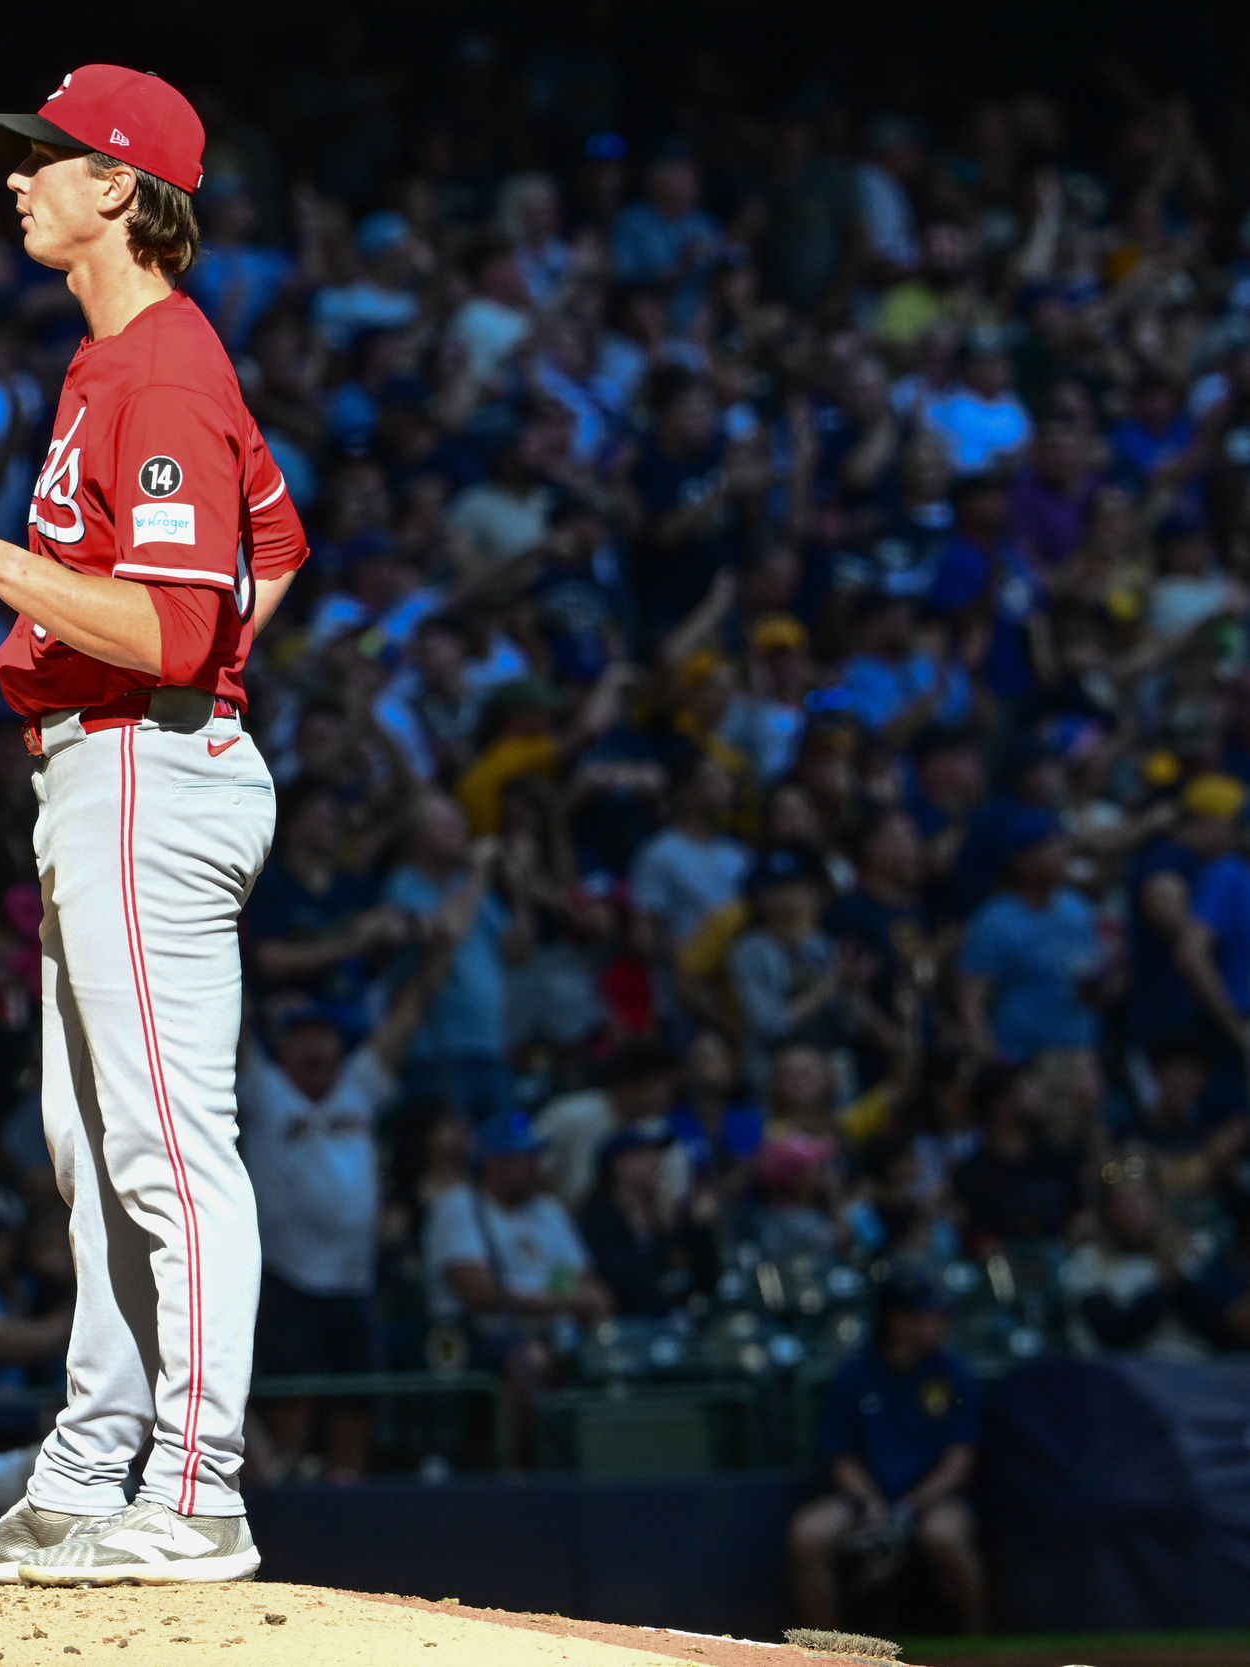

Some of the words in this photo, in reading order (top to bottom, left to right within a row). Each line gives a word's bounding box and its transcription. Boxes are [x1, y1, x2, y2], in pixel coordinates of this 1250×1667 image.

[29, 407, 86, 545] ds
[148, 463, 173, 491] 14
[148, 510, 189, 535] Kroger
